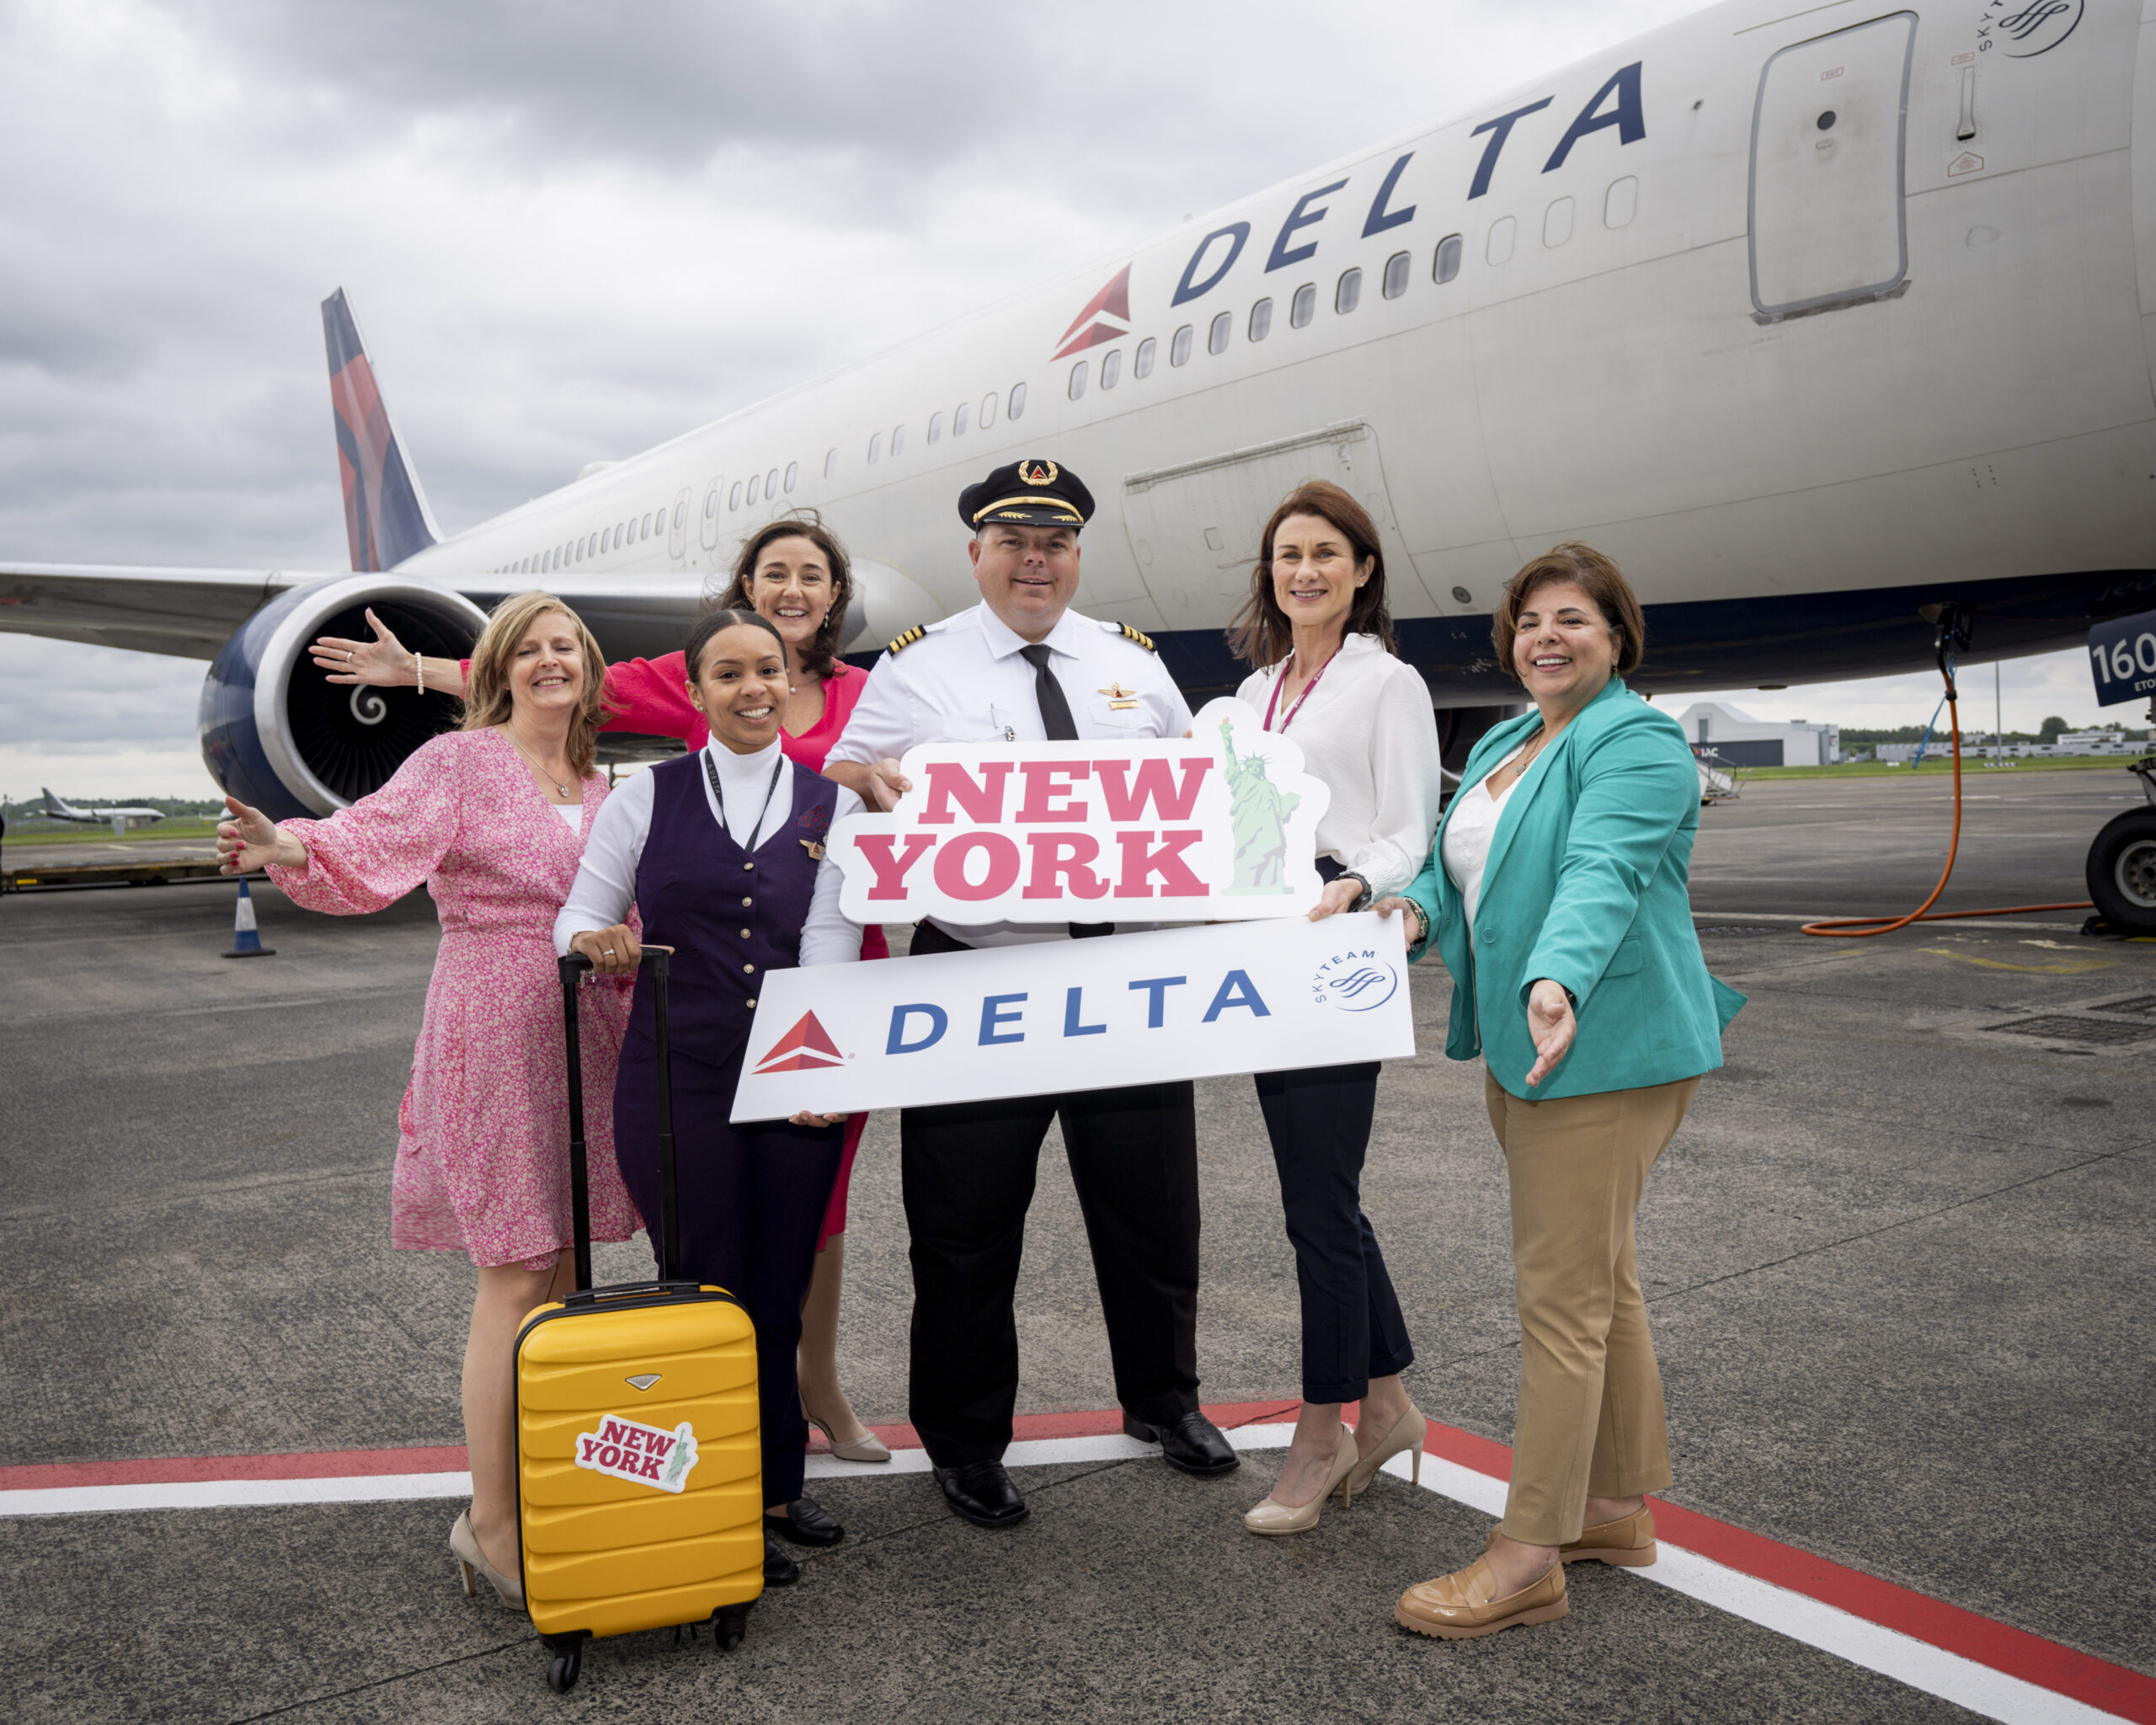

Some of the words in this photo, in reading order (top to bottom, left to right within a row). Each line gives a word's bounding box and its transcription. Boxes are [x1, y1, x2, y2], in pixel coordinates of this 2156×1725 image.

[1171, 61, 1646, 308] DELTA
[2092, 633, 2156, 684] 160
[2134, 677, 2156, 692] ETO
[709, 770, 721, 794] DELTA
[918, 756, 1214, 825] NEW
[853, 830, 1210, 901] YORK
[885, 969, 1272, 1055] DELTA
[1312, 950, 1376, 1003] SKYTEAM
[582, 1439, 664, 1481] YORK
[600, 1420, 675, 1457] NEW
